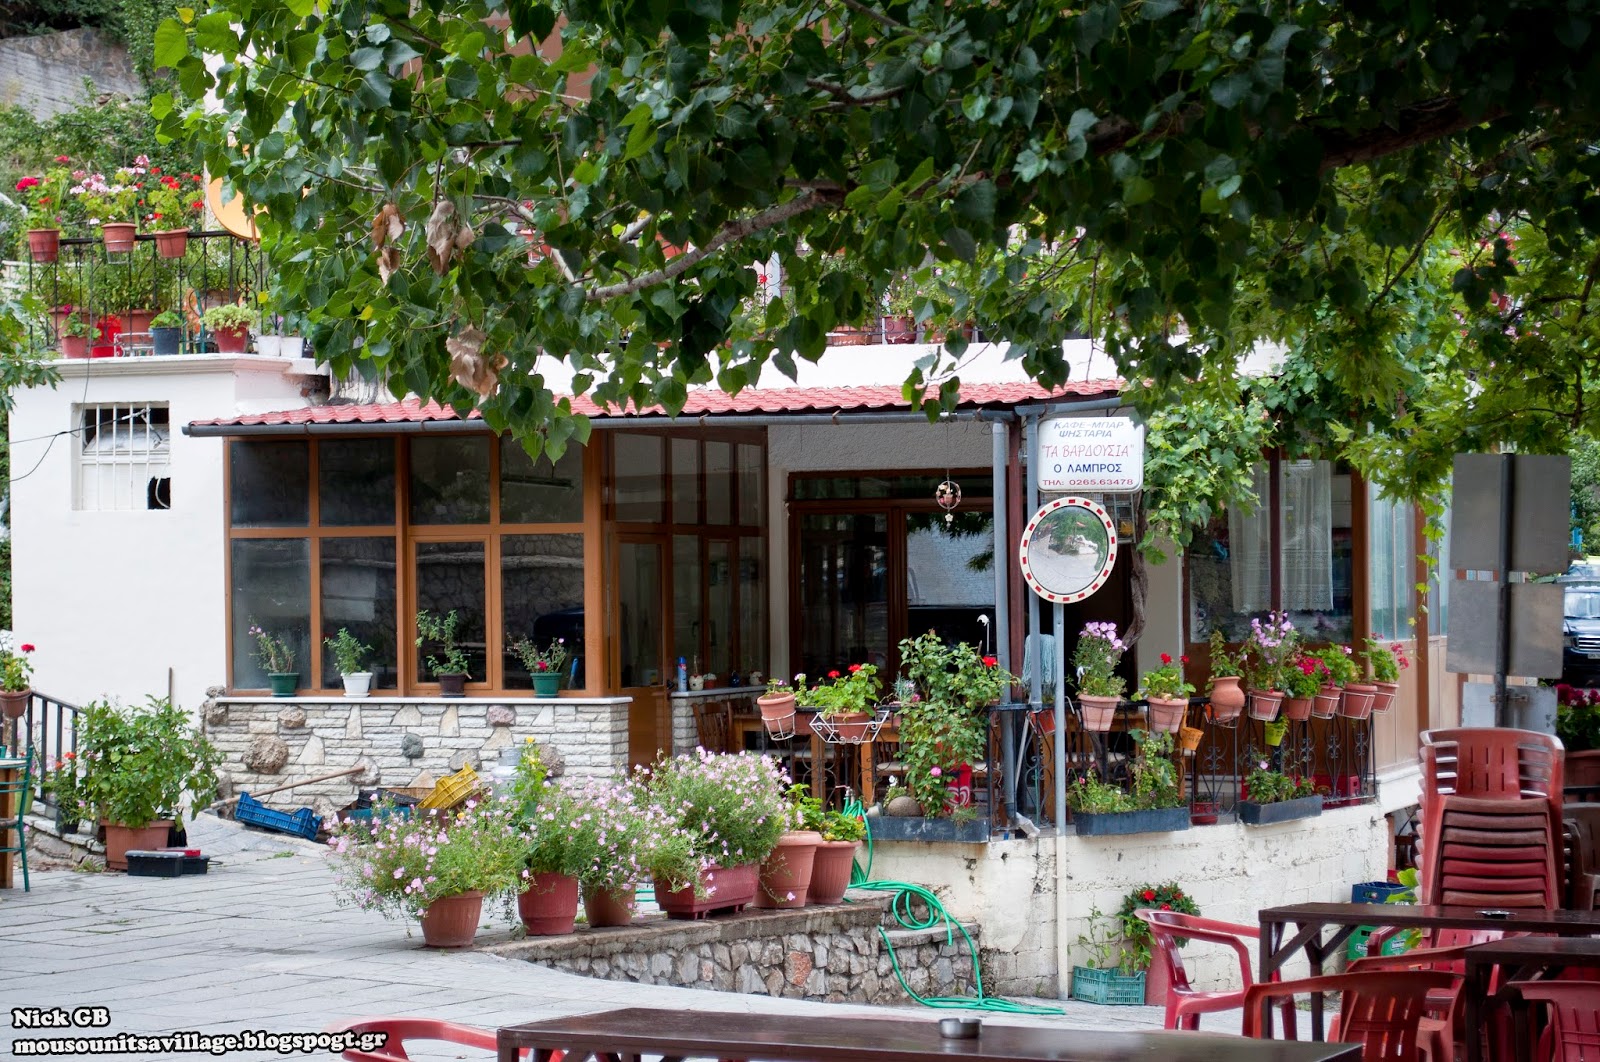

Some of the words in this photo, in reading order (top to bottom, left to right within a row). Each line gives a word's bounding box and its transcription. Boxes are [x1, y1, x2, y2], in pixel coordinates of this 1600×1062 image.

[1054, 421, 1124, 429] ΚΑΦΕ-ΜΠΑΡ
[1042, 445, 1059, 458] "ΤΑ
[1062, 444, 1134, 457] ΒΑΡΔΟΥΣΙΑ"
[1053, 464, 1062, 473] Ο
[1067, 464, 1122, 473] ΛΑΜΠΡΟΣ
